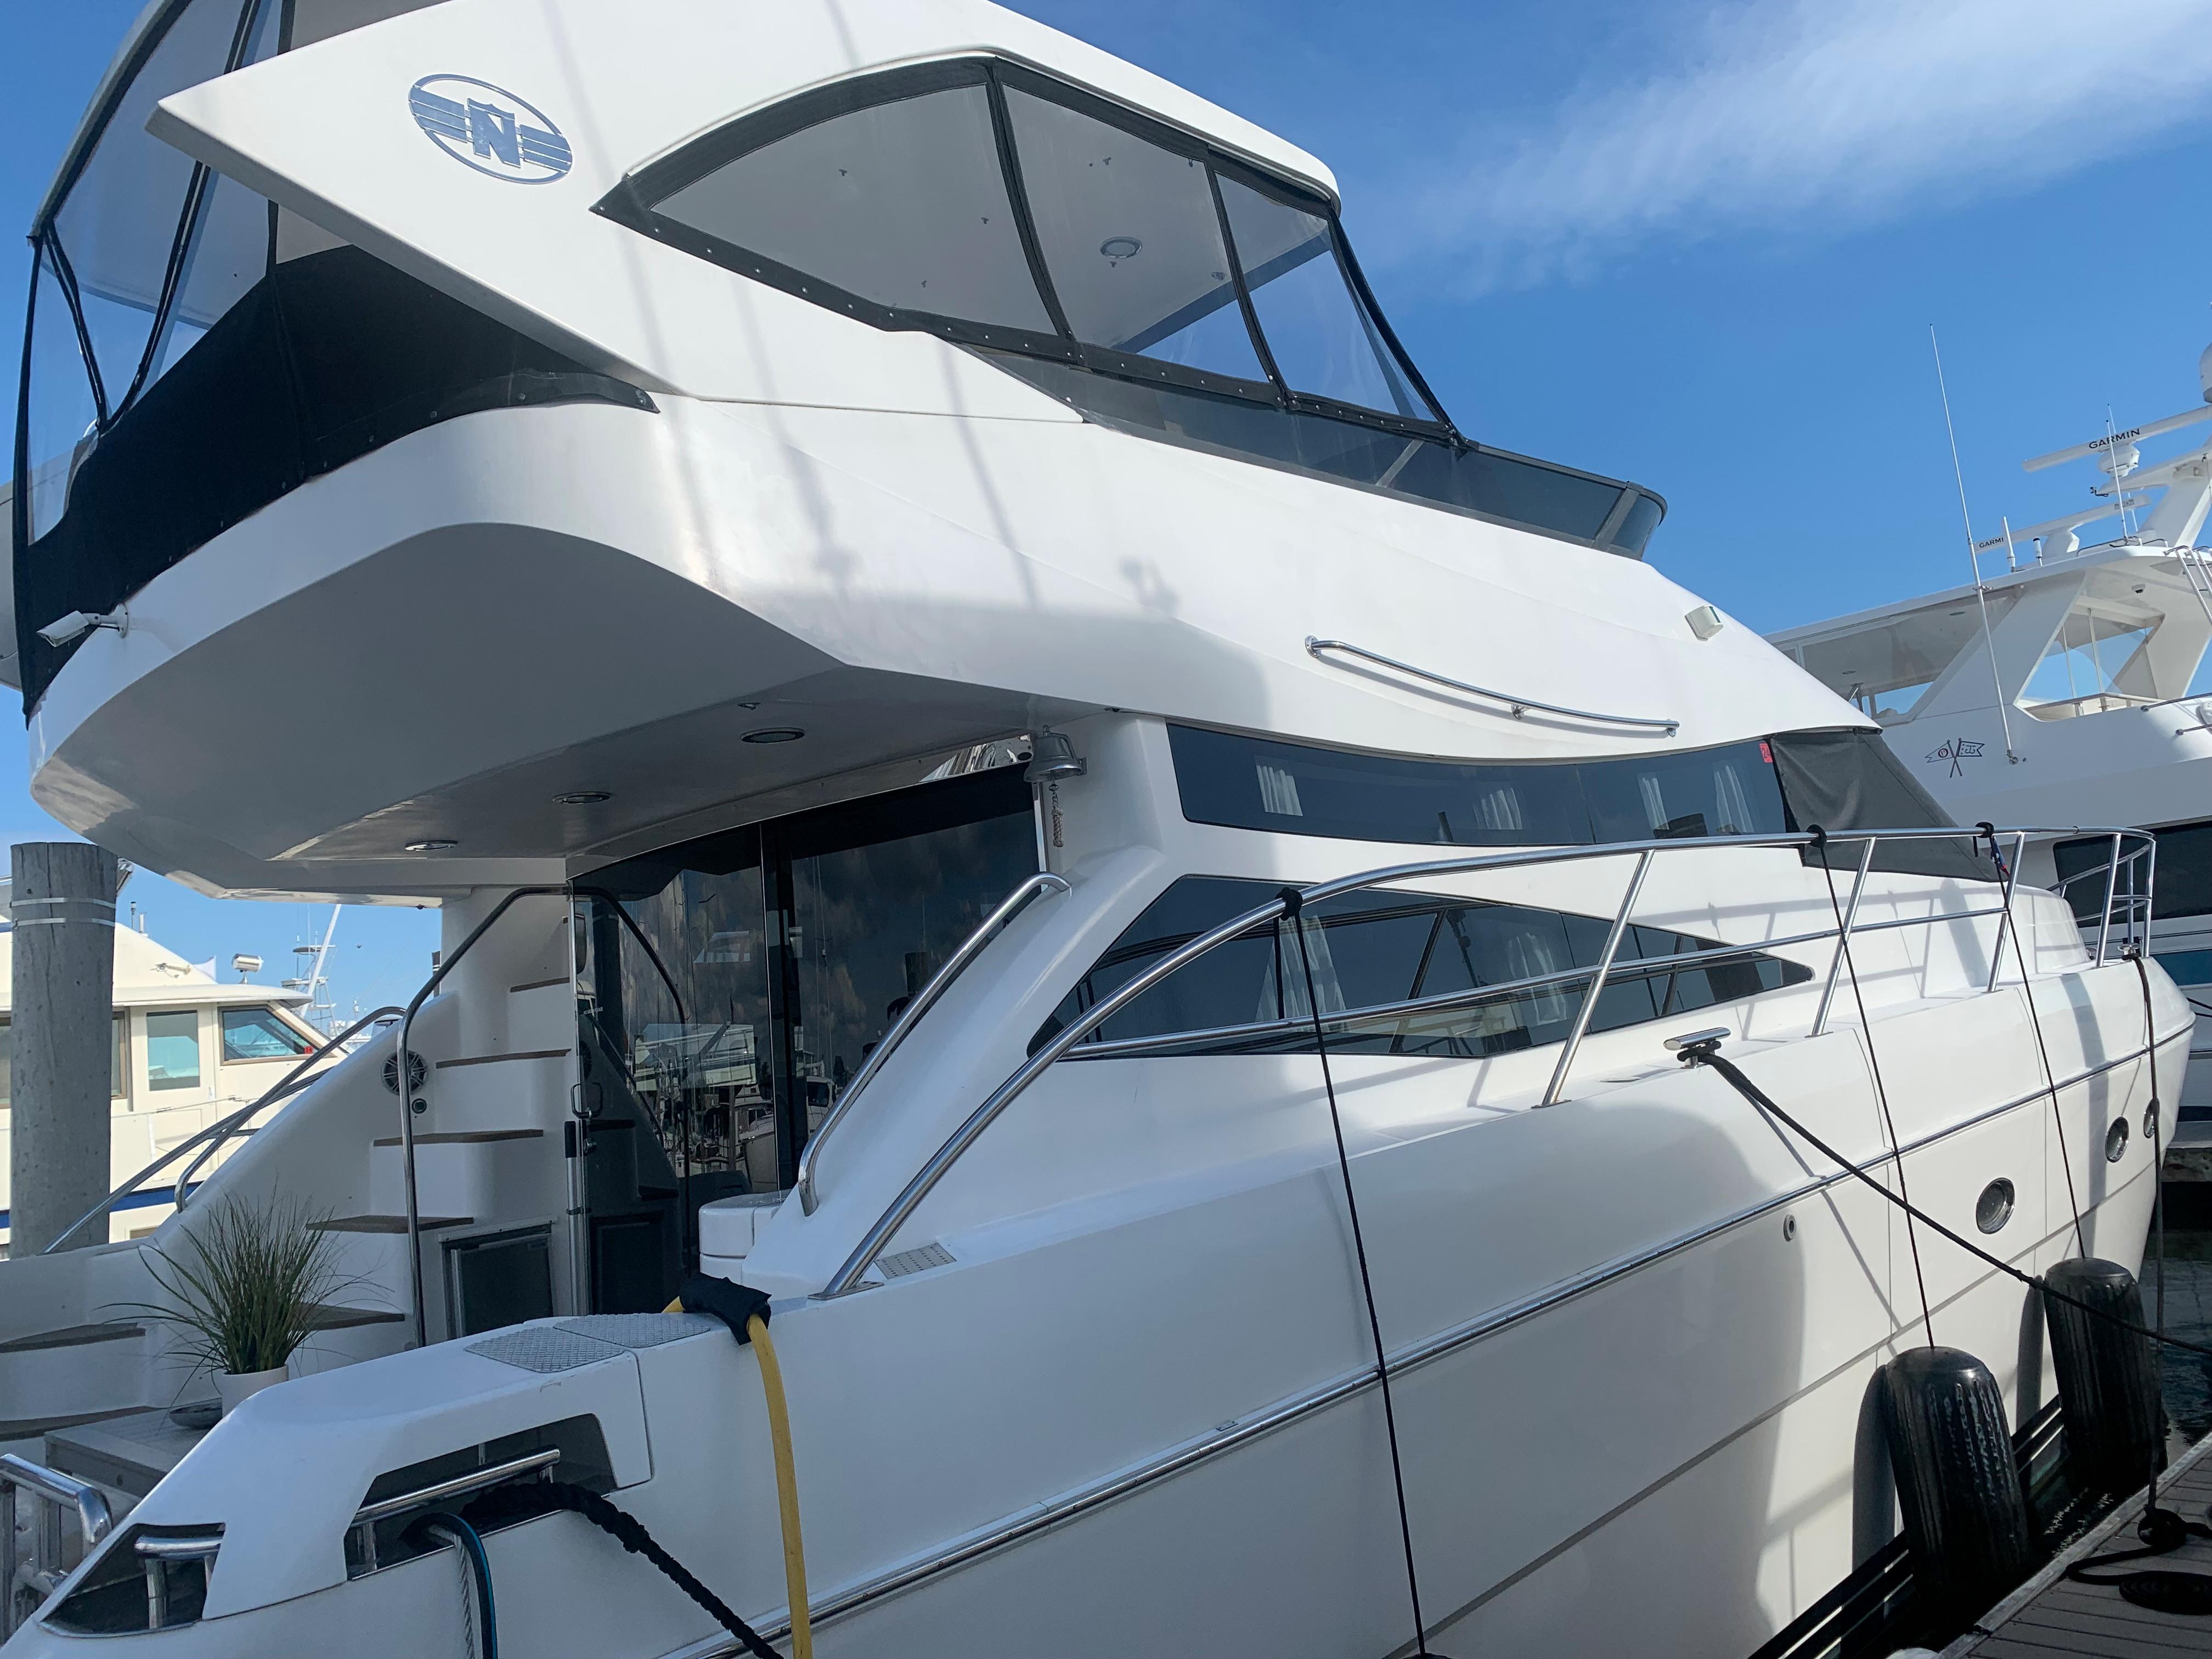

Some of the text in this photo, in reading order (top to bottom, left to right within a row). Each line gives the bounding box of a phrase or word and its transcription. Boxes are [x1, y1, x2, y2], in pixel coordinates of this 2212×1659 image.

[467, 98, 521, 168] N
[2089, 428, 2140, 449] GARMIN
[1979, 537, 2004, 548] GARMI
